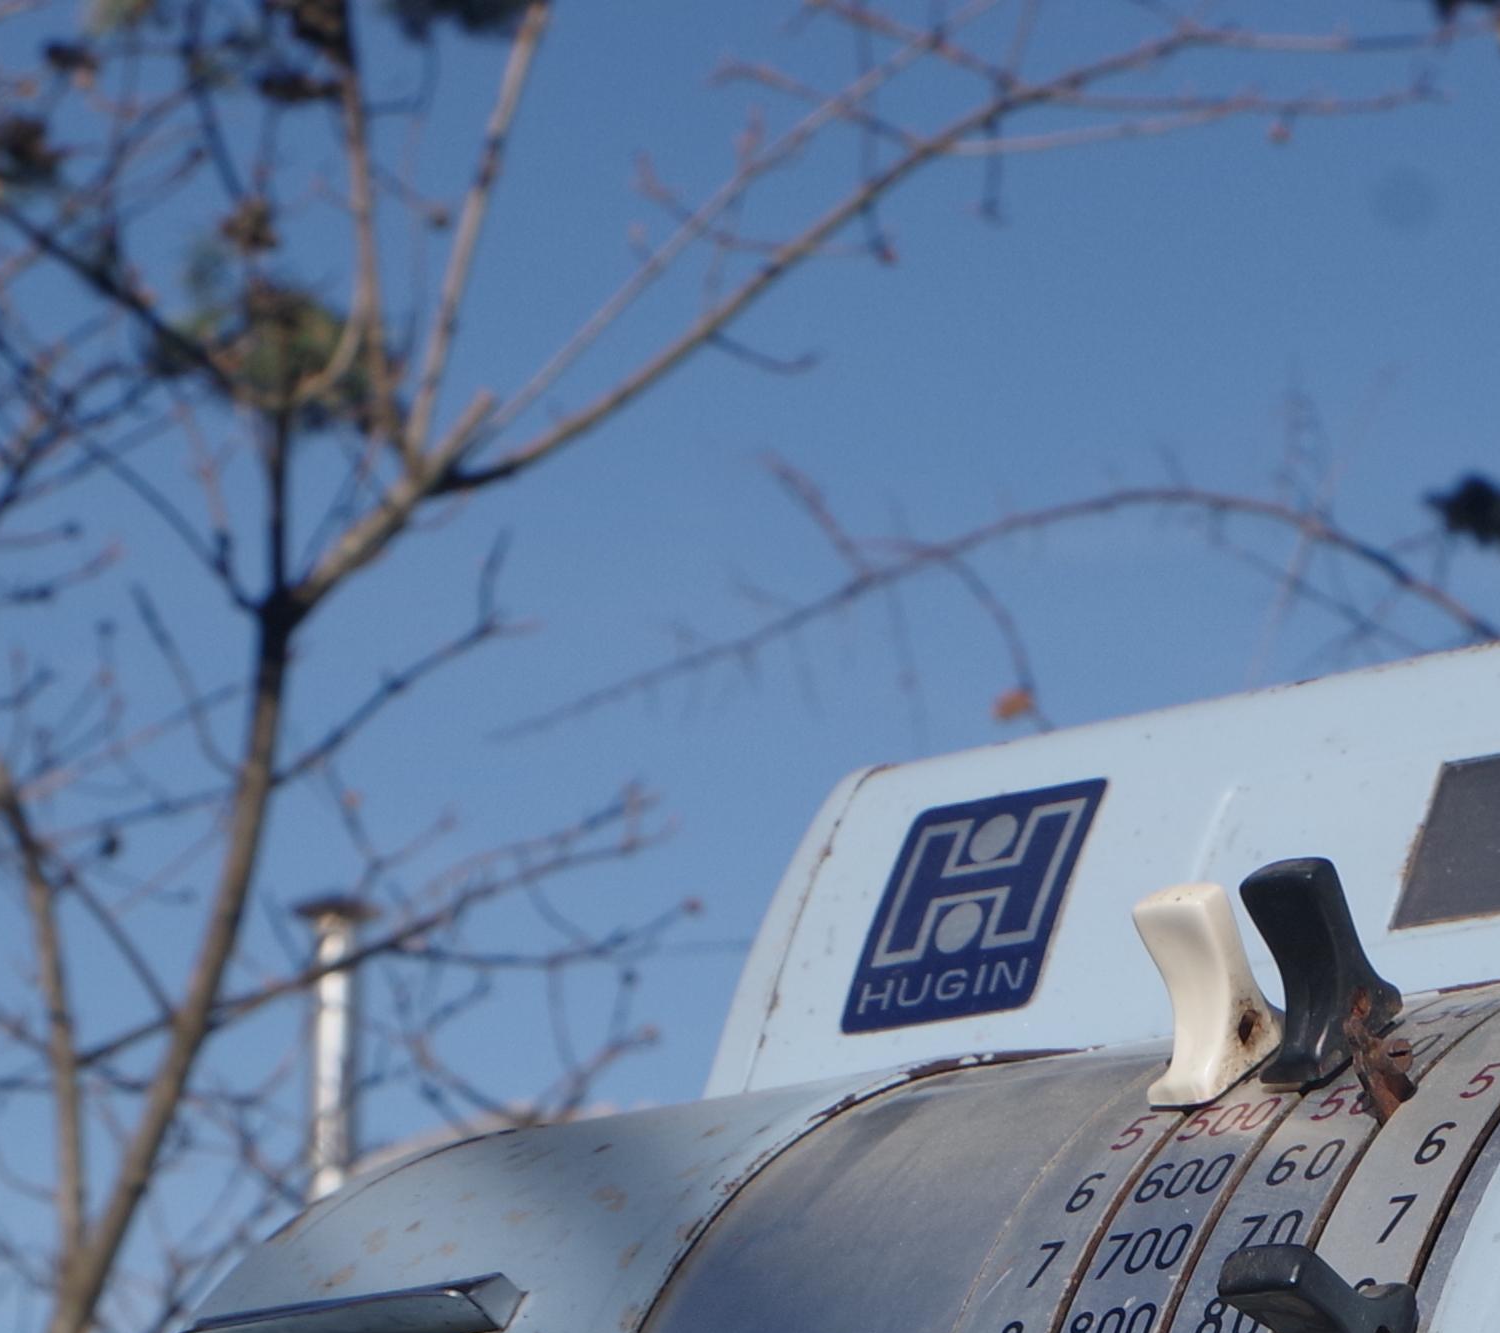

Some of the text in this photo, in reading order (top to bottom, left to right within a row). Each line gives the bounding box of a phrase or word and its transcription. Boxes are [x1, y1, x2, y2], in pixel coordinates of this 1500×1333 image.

[857, 957, 1028, 1014] HUGIN
[1112, 1116, 1157, 1150] 5
[1178, 1097, 1281, 1142] 500
[1066, 1121, 1456, 1212] 6 600 60 6
[1026, 1194, 1417, 1288] 7 700 70 7
